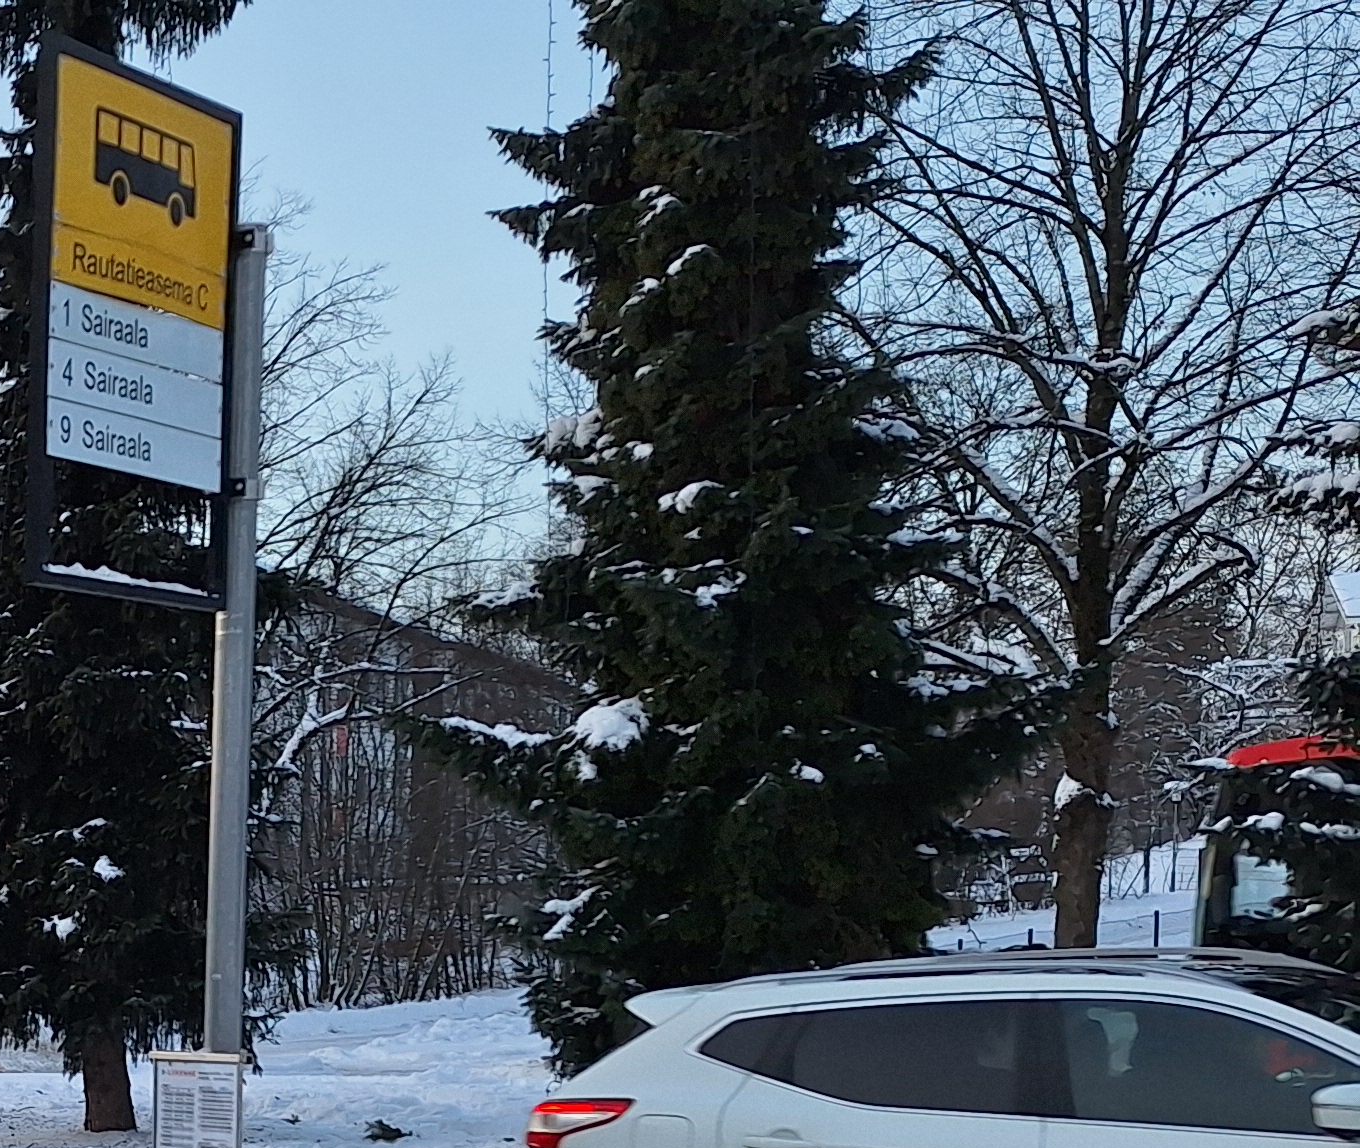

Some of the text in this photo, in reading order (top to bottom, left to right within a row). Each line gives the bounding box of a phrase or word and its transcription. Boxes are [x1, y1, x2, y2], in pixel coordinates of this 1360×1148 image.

[71, 241, 209, 311] Rautatieasema C
[62, 298, 149, 348] 1 Sairaala
[62, 357, 153, 405] 4 Sairaala
[60, 415, 152, 462] 9 Sairaala
